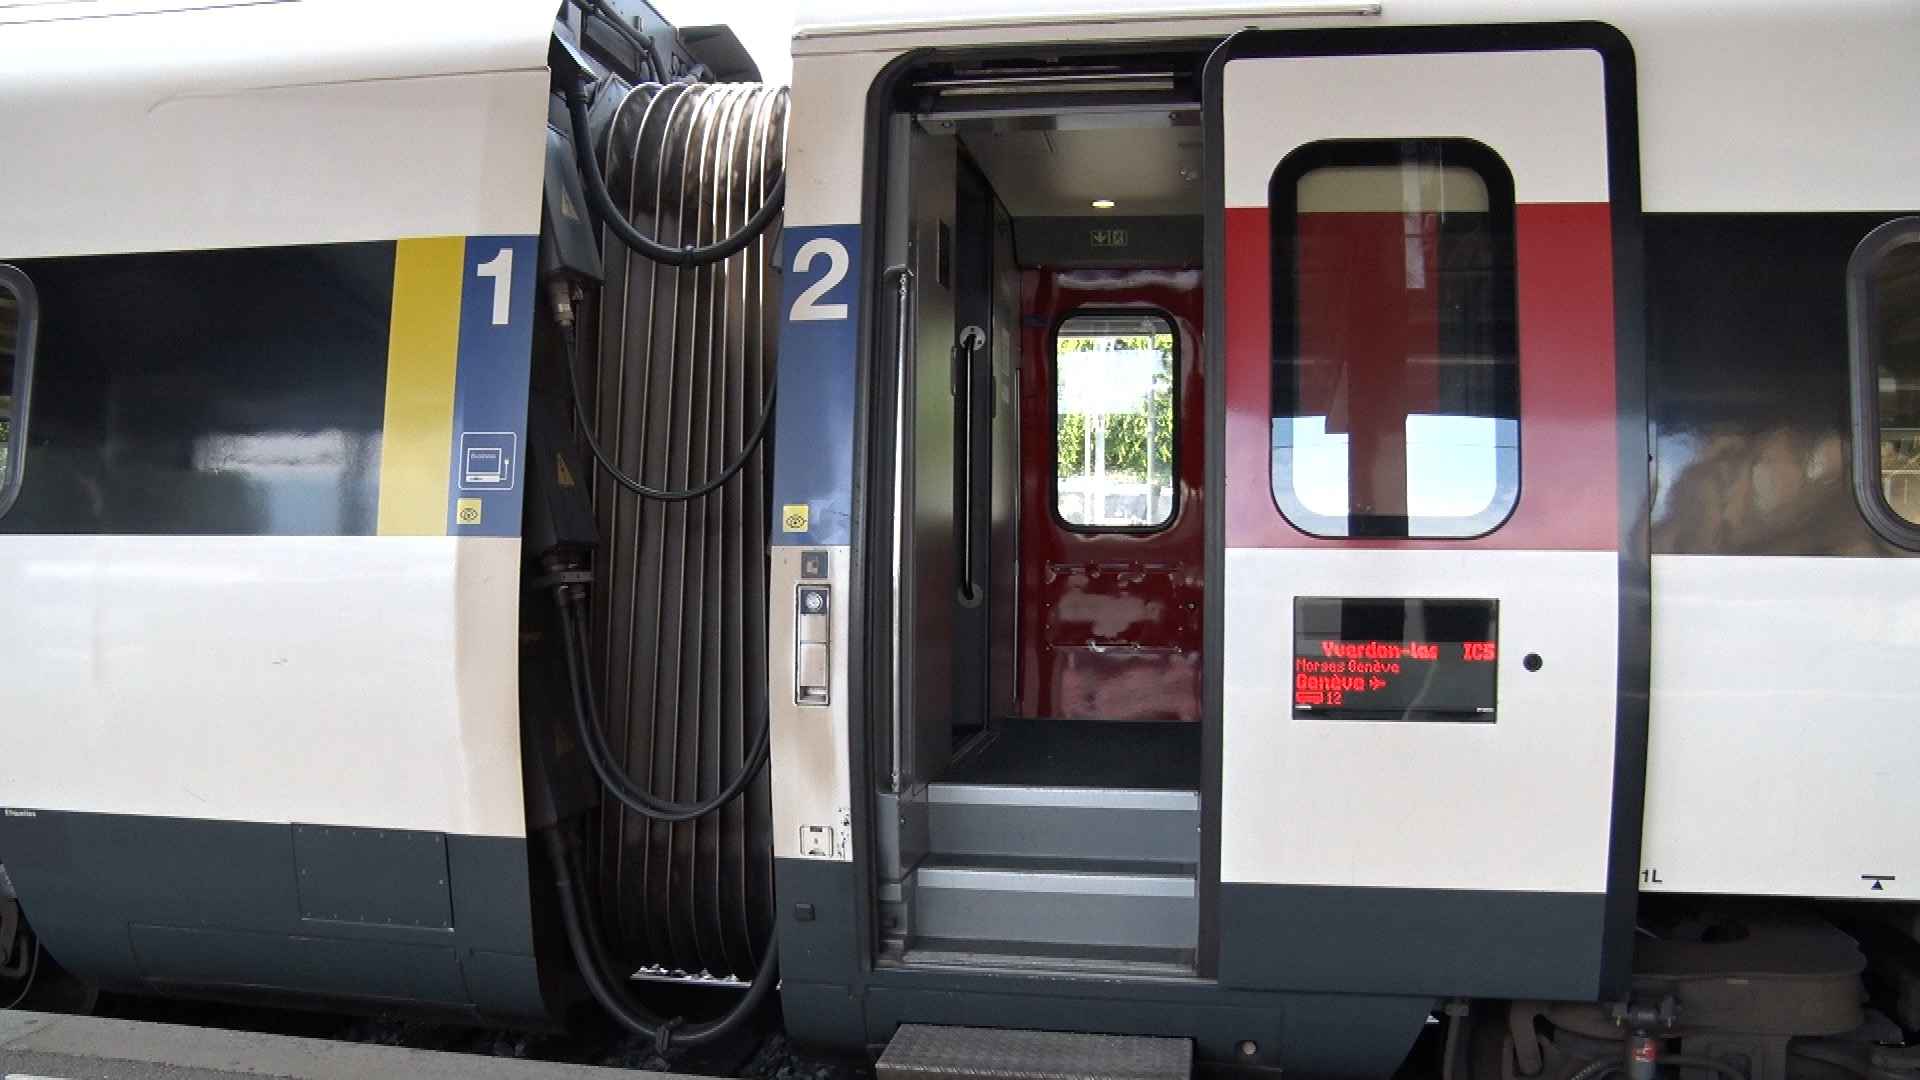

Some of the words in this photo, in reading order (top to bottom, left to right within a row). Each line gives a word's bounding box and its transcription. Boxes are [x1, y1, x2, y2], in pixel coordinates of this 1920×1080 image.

[476, 247, 514, 325] 1
[789, 237, 850, 321] 2
[1463, 642, 1496, 661] IC5
[1326, 691, 1342, 705] 12
